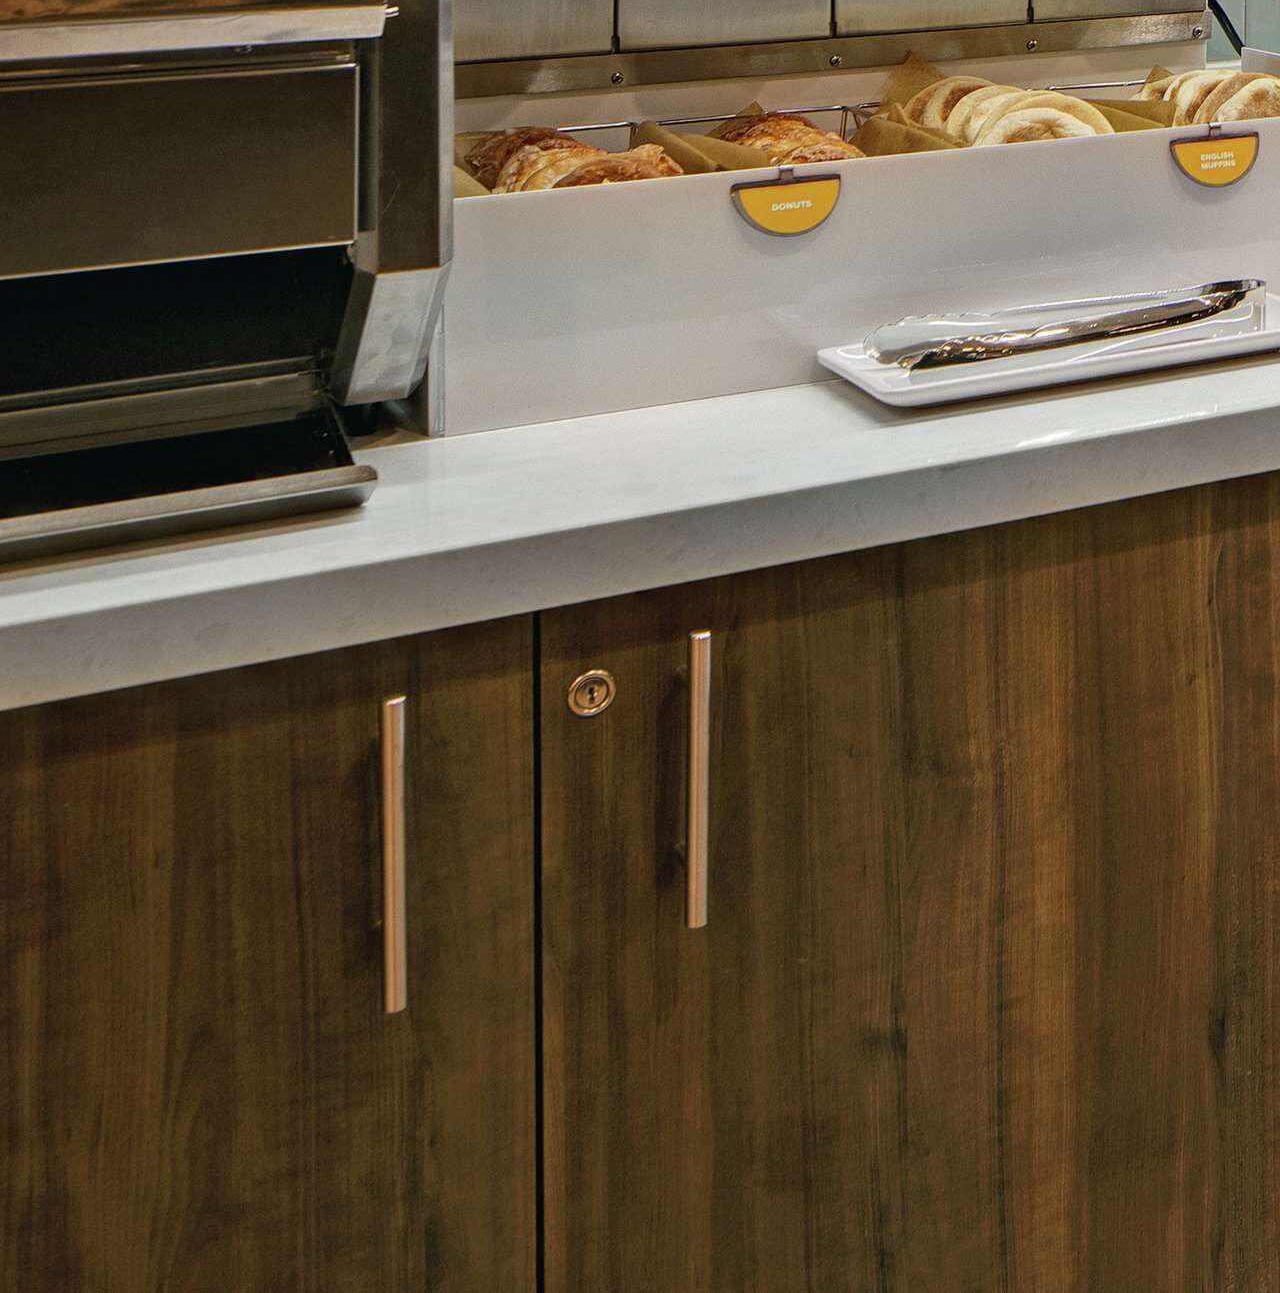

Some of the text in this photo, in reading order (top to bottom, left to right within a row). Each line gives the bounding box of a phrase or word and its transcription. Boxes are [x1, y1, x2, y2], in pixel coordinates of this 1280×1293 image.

[1200, 151, 1234, 162] ENGLISH
[1200, 159, 1236, 170] MUFFINS
[771, 199, 813, 211] DONUTS
